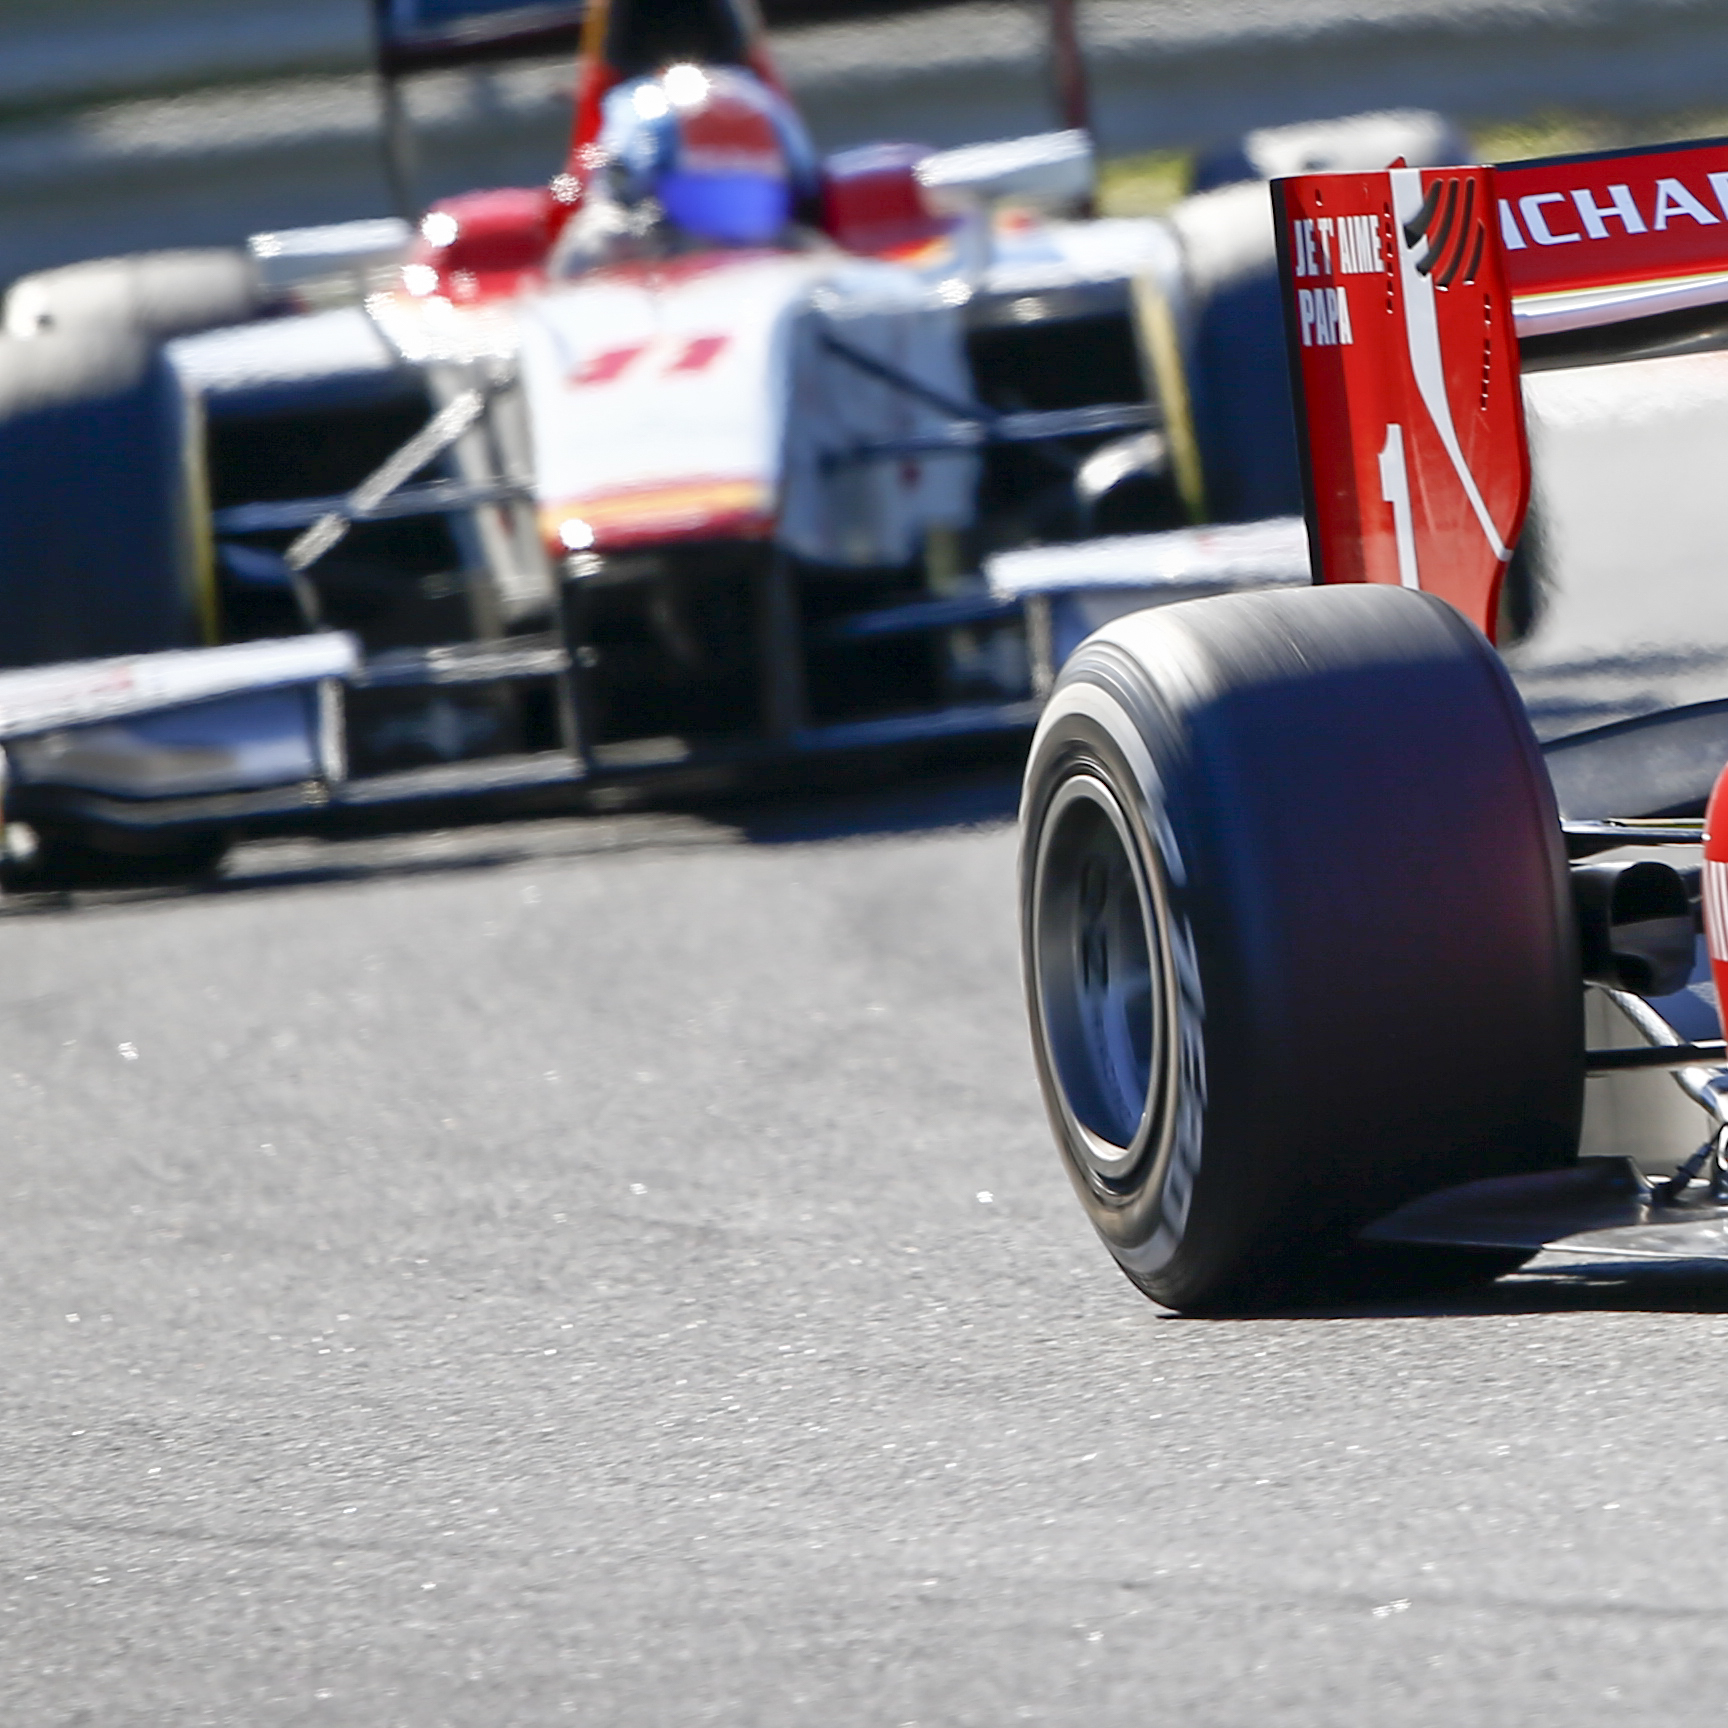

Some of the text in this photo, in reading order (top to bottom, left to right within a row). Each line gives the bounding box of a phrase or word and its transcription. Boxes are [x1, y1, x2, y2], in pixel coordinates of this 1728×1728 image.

[1293, 218, 1320, 277] JE
[1298, 285, 1354, 347] PAPA
[1377, 423, 1420, 592] 1
